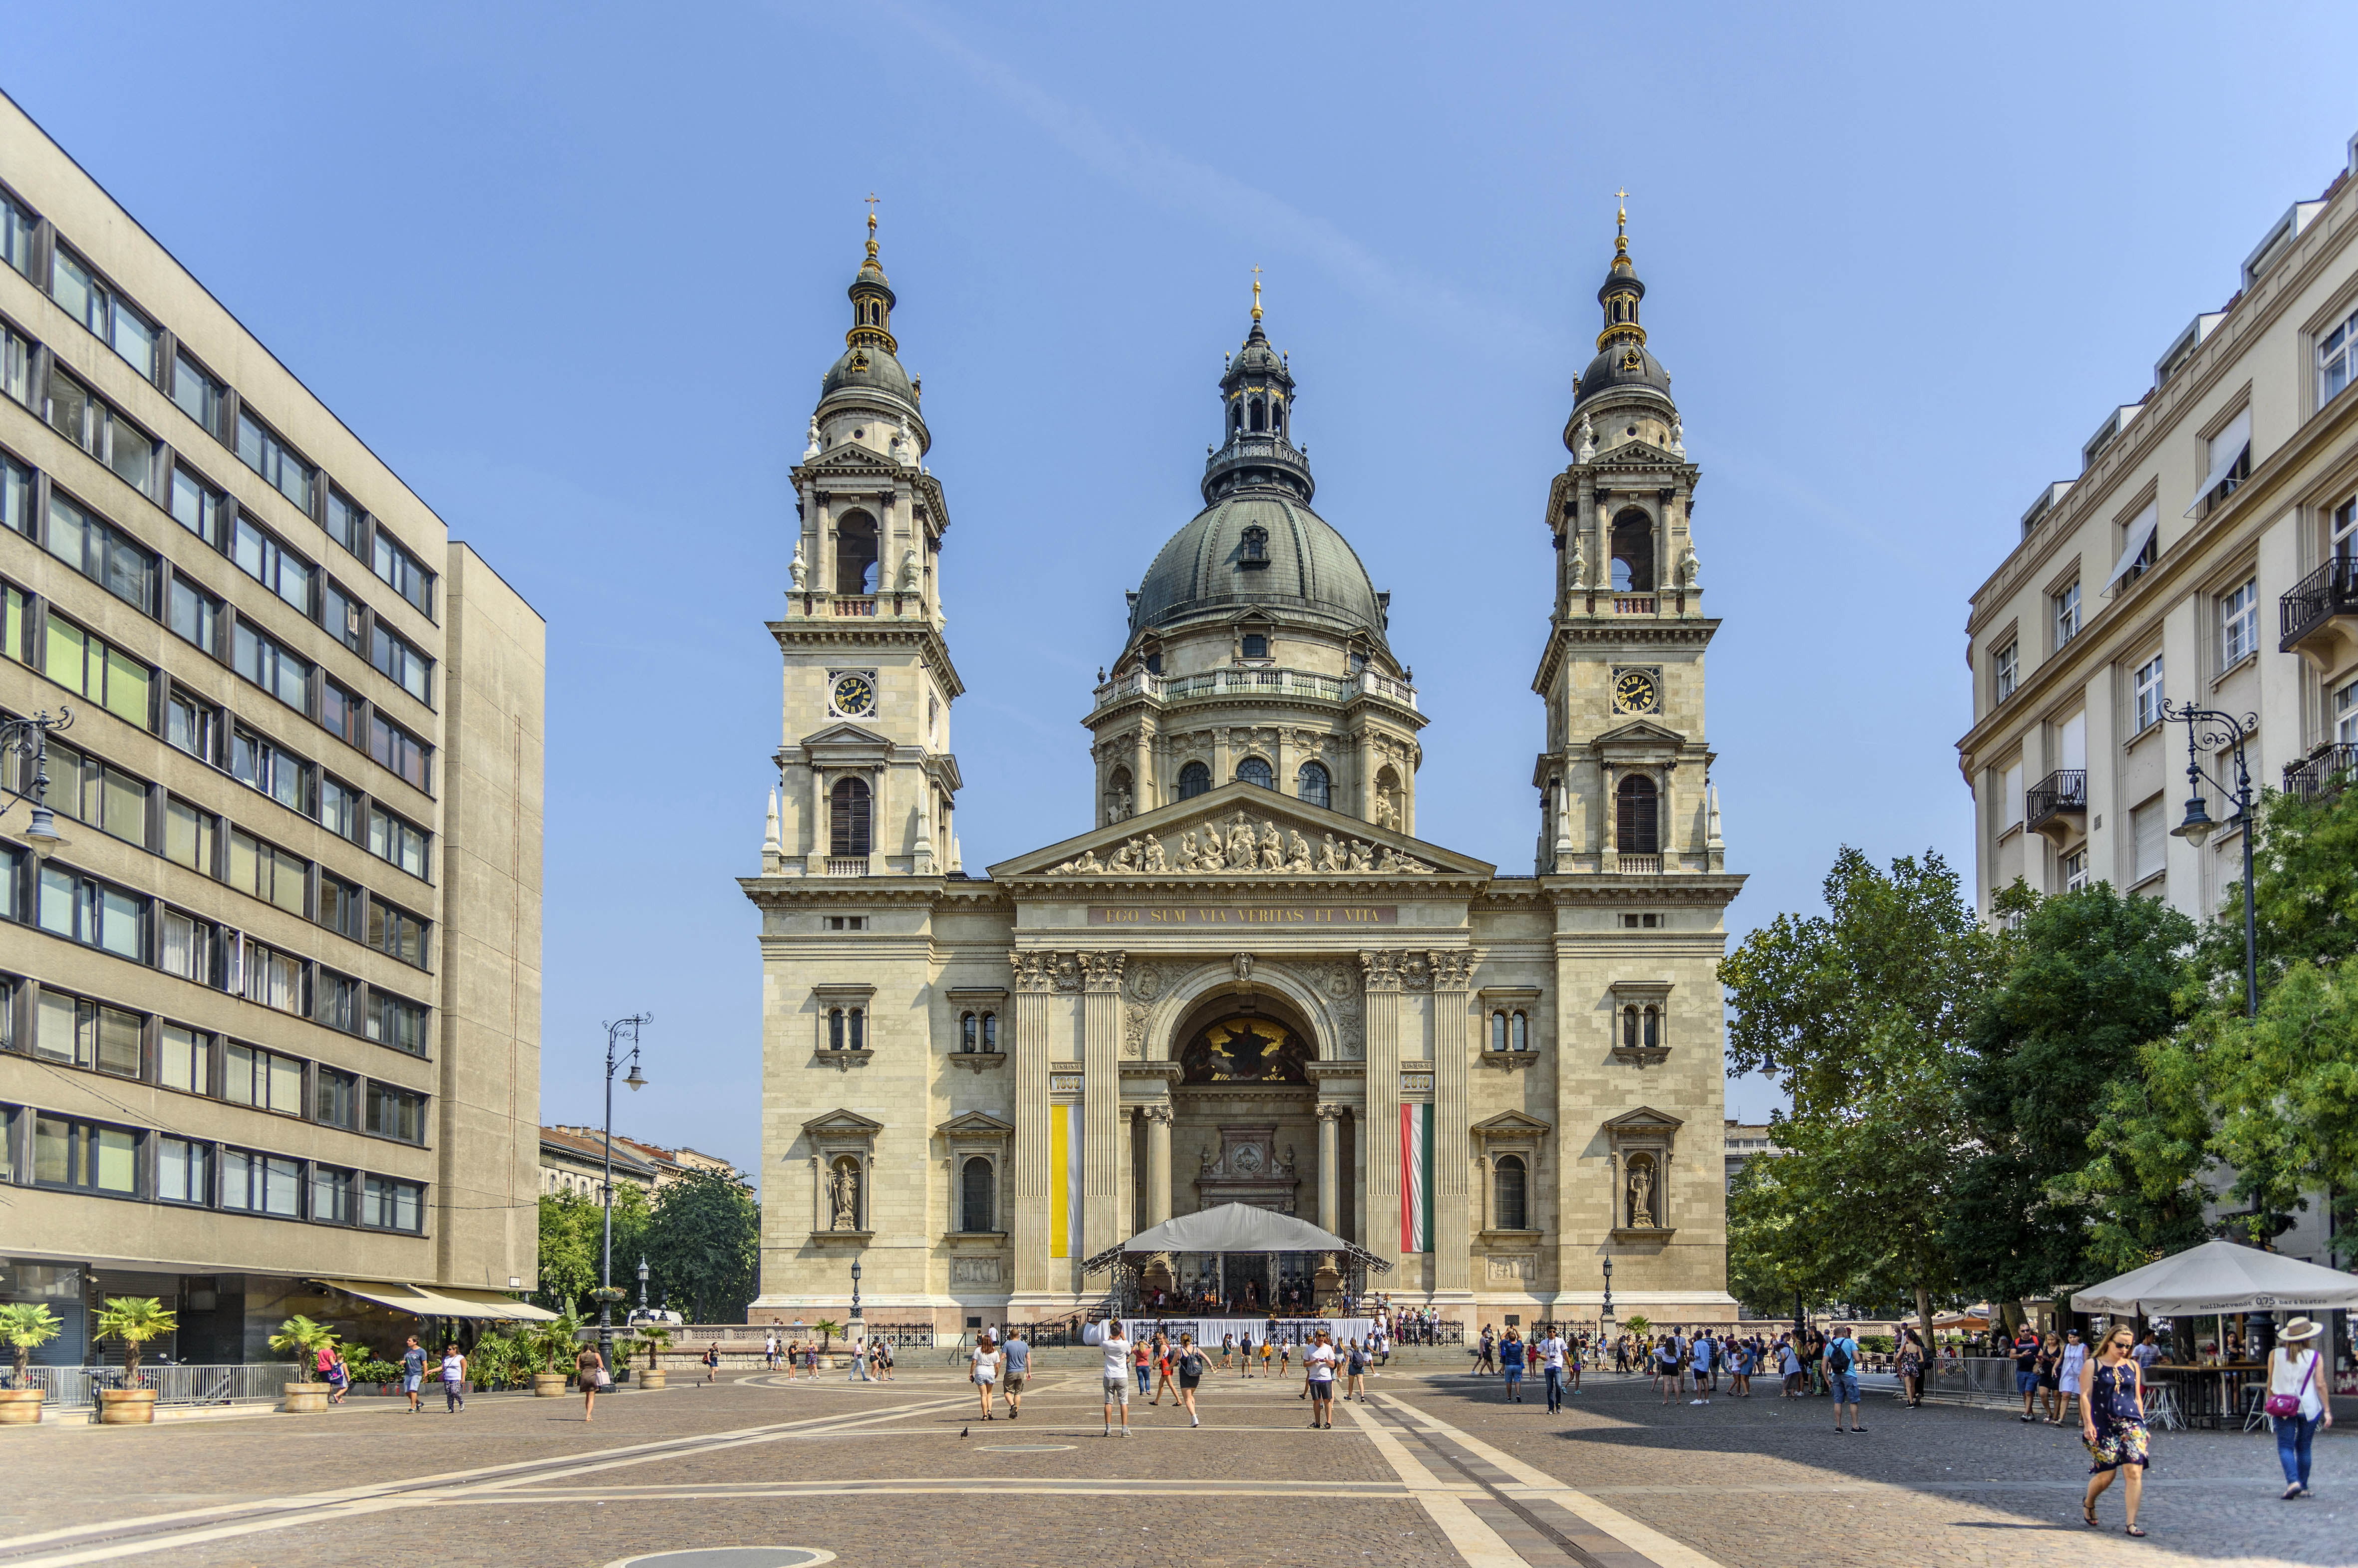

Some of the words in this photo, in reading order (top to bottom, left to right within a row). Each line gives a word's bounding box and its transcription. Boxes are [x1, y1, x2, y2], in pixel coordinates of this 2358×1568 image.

[1106, 910, 1139, 923] EGO
[1151, 910, 1186, 923] SUM
[1199, 910, 1227, 923] VIA
[1238, 909, 1304, 922] VERITAS
[1314, 909, 1334, 922] ET
[1344, 909, 1379, 922] VITA
[1055, 1077, 1080, 1089] 1038
[1404, 1076, 1430, 1088] 2018
